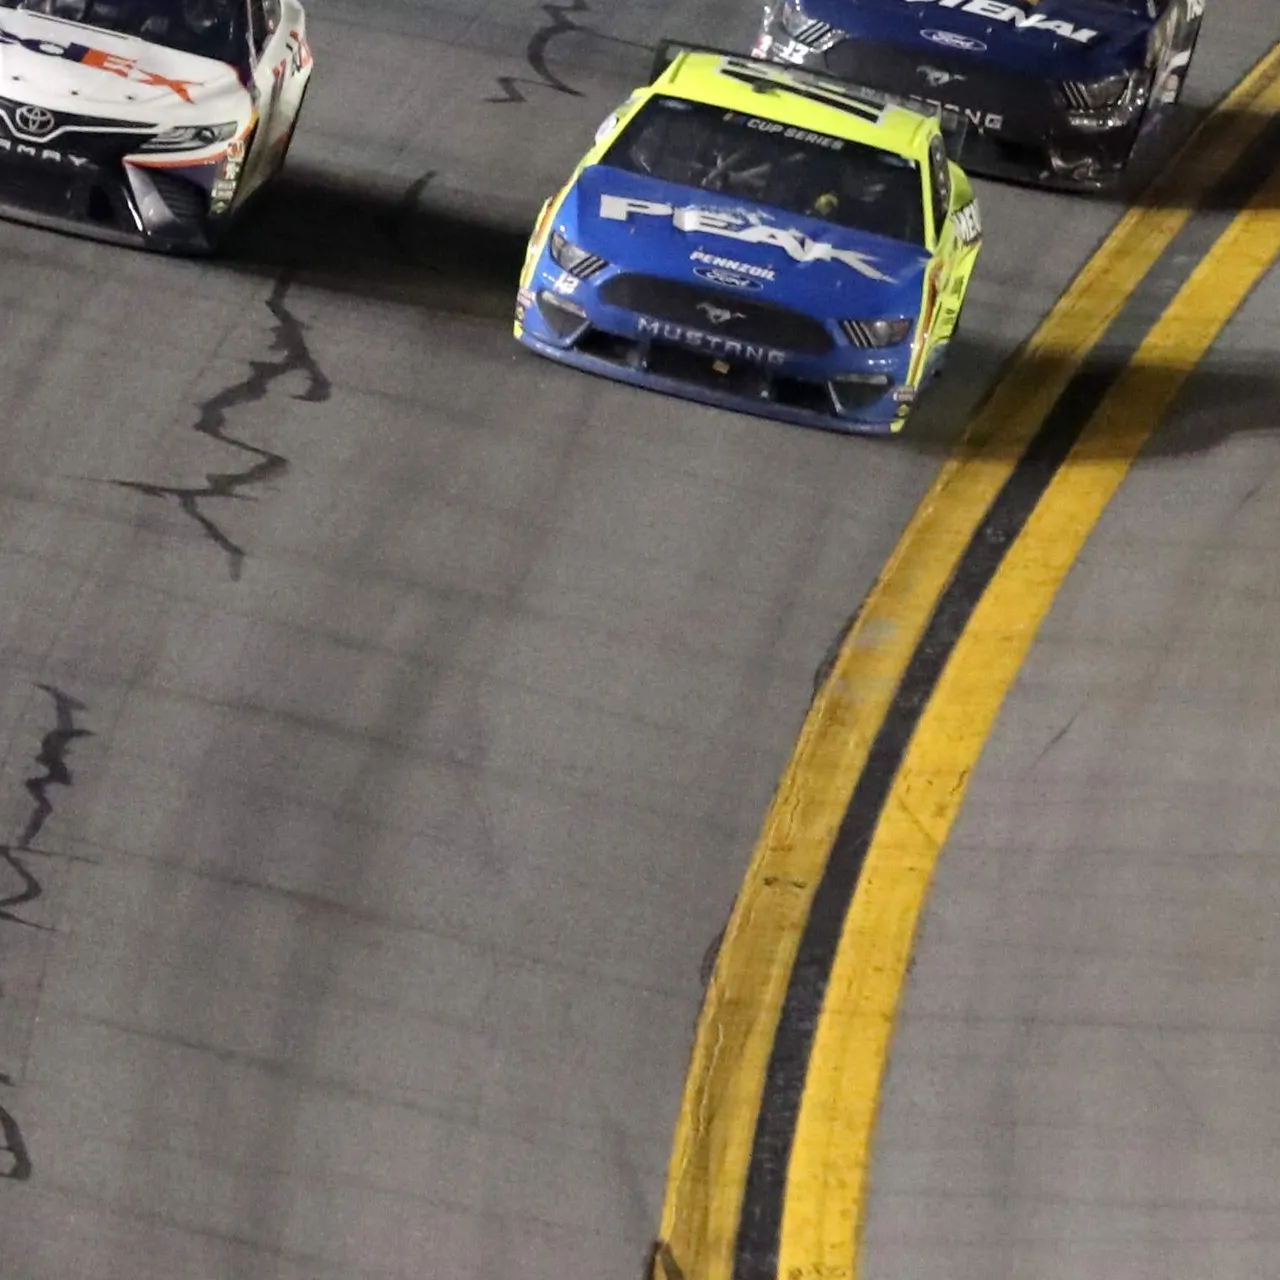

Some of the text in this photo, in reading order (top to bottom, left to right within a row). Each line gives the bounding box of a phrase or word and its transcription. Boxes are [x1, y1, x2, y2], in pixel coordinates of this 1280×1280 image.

[746, 117, 844, 151] CUP SERIES
[599, 194, 900, 285] PEAK
[689, 247, 777, 282] PENNZOIL
[636, 317, 787, 365] MUSTANG
